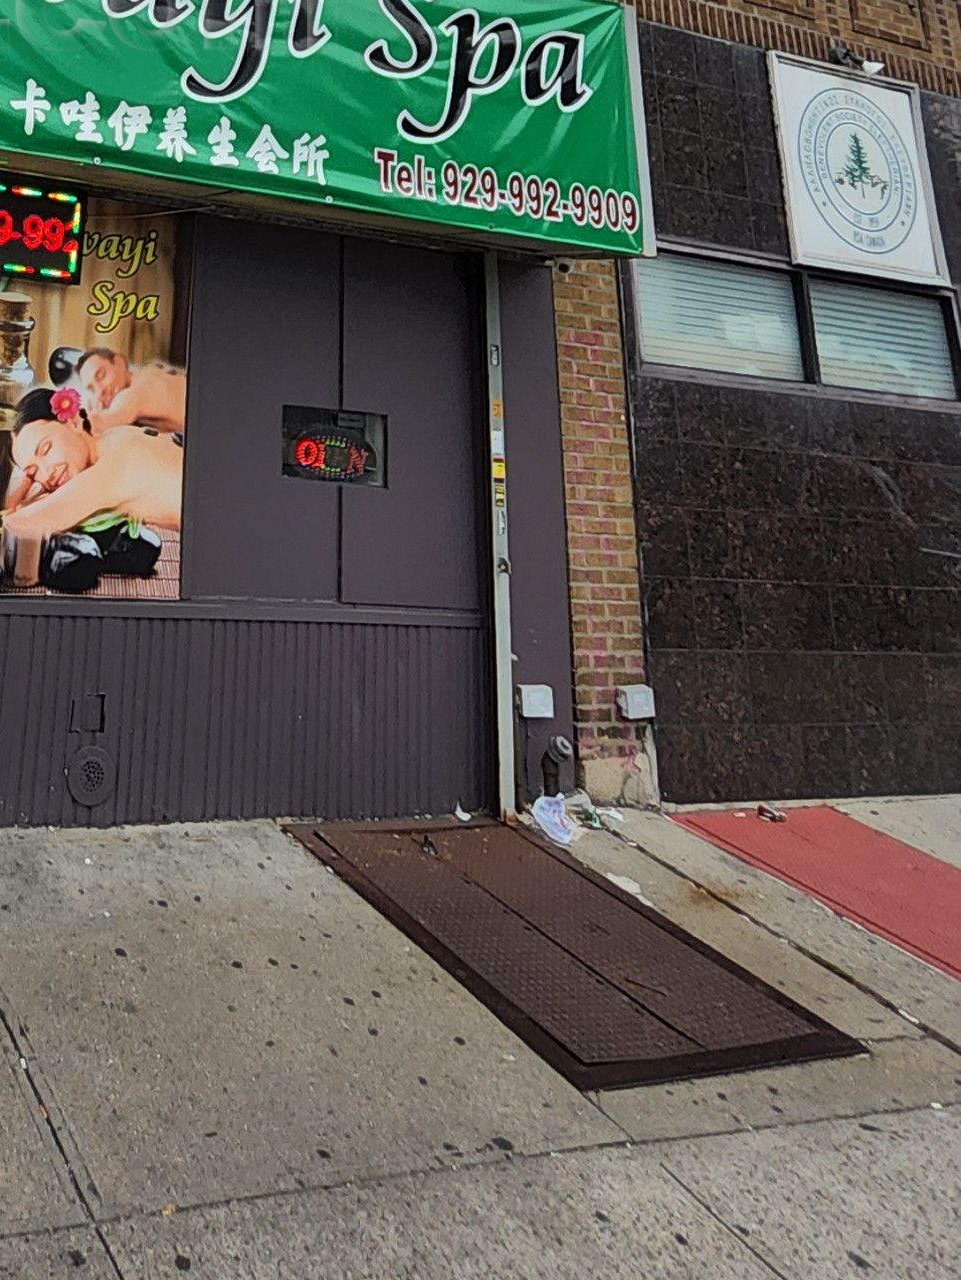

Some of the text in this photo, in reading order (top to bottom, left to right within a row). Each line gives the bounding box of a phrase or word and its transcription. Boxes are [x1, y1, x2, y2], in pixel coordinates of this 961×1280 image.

[10, 78, 331, 186] 卡哇伊养生会所
[374, 146, 639, 235] Tel: 929-992-9909
[87, 280, 159, 334] Spa
